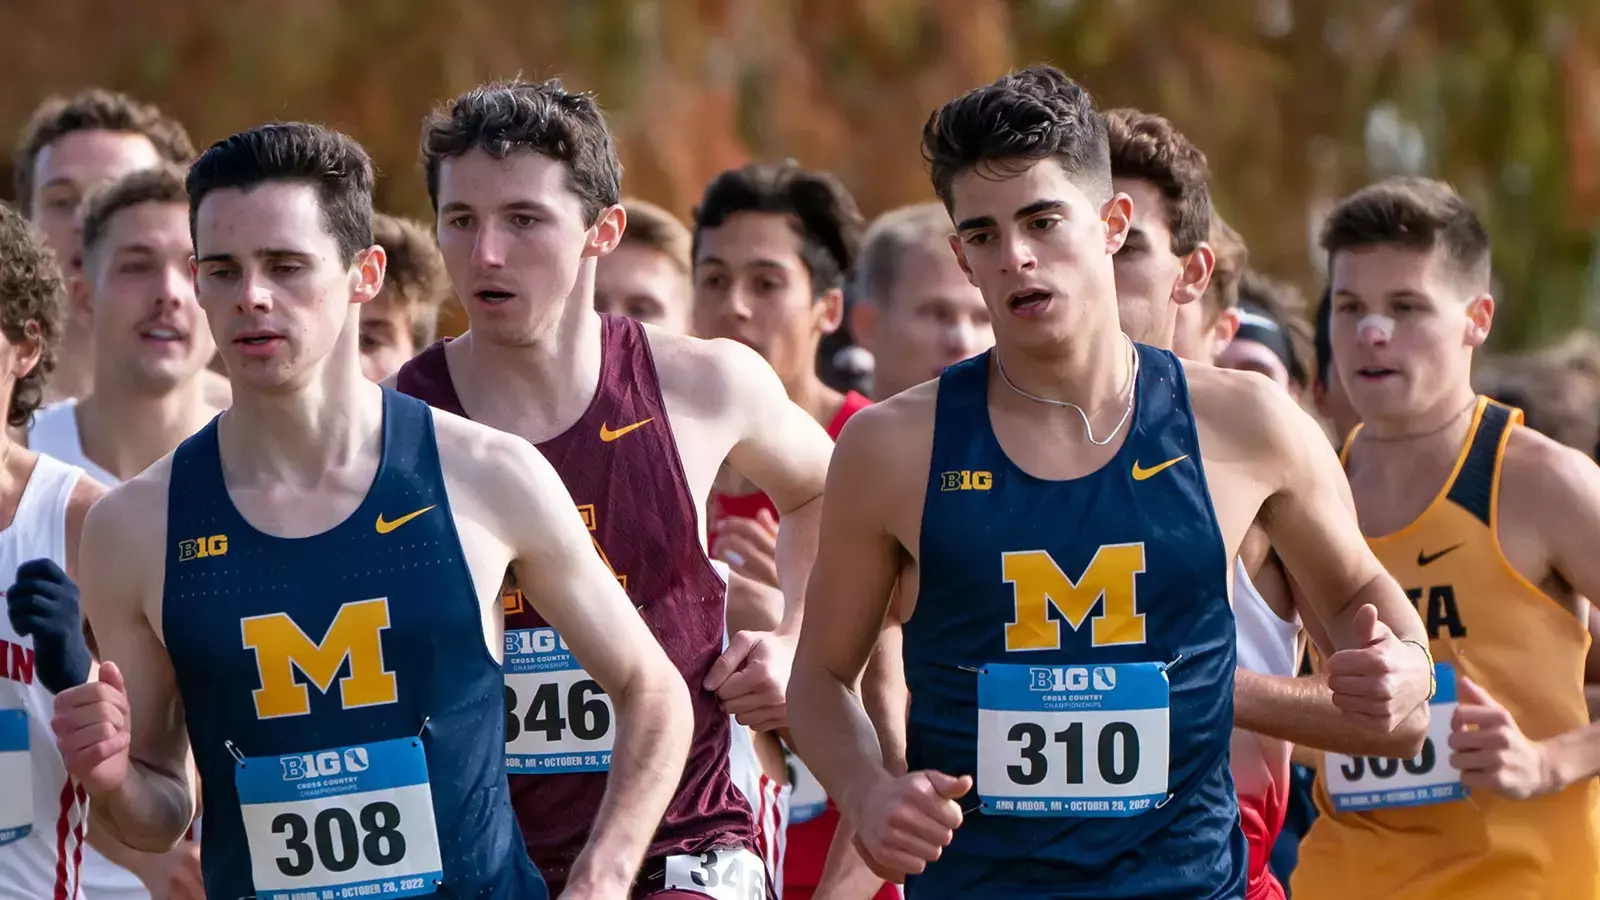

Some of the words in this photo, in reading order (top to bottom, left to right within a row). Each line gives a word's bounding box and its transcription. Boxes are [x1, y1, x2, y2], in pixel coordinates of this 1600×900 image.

[1001, 541, 1147, 652] M
[240, 597, 398, 720] M
[536, 654, 570, 663] COUNTRY
[513, 661, 569, 671] CHAMPIONSHIPS
[1006, 721, 1140, 786] 310
[525, 759, 537, 768] MI
[544, 756, 583, 768] OCTOBER
[584, 755, 600, 767] 28,
[297, 780, 323, 790] CROSS
[323, 776, 358, 787] COUNTRY
[300, 785, 358, 797] CHAMPIONSHIPS
[996, 801, 1014, 811] ANN
[1016, 801, 1048, 812] ARBOR,
[1051, 801, 1062, 811] MI
[1070, 800, 1109, 811] OCTOBER
[1112, 800, 1126, 812] 28,
[1129, 799, 1151, 811] 2022
[271, 801, 406, 877] 308
[341, 883, 381, 897] OCTOBER
[400, 877, 424, 891] 2022
